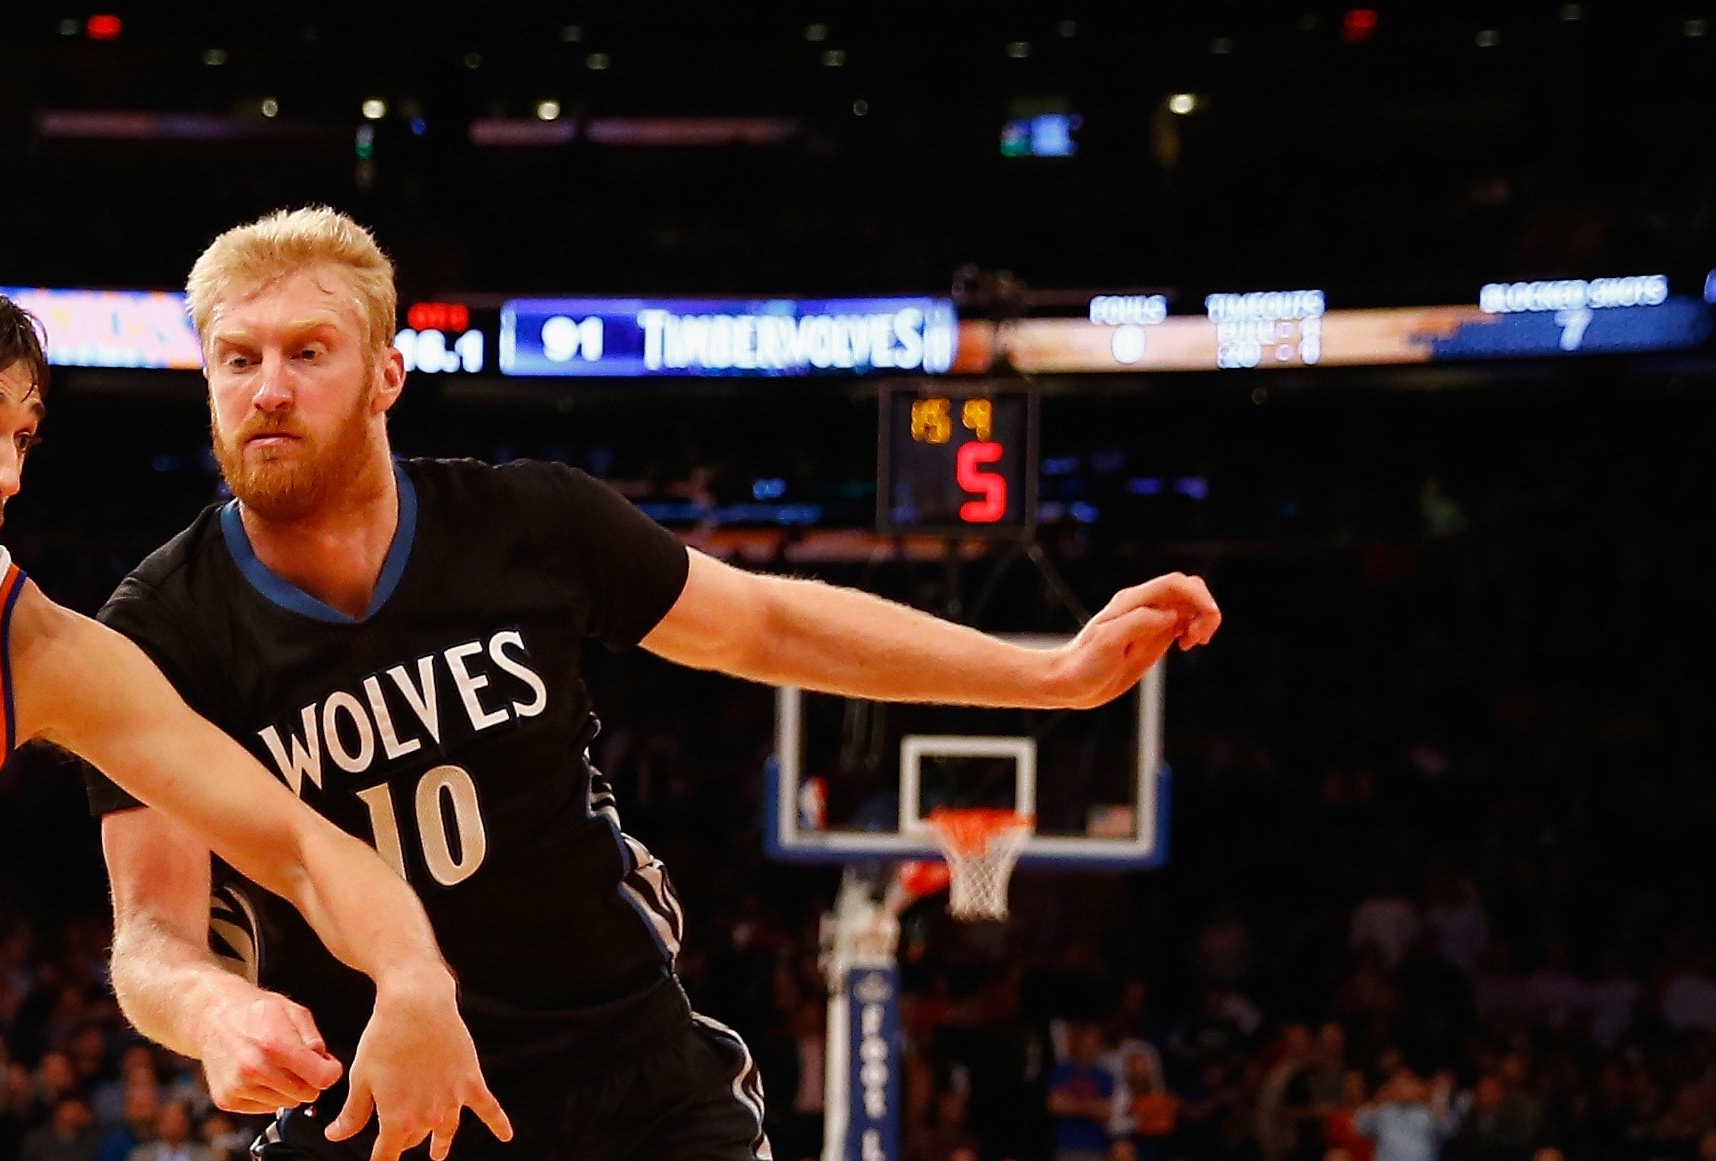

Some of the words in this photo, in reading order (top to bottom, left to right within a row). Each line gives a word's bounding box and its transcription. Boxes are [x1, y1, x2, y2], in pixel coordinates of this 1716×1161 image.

[541, 315, 604, 362] 91
[637, 308, 924, 370] TIMBERWOLVES
[956, 440, 1007, 523] 5
[257, 630, 547, 799] WOLVES
[355, 765, 486, 887] 10
